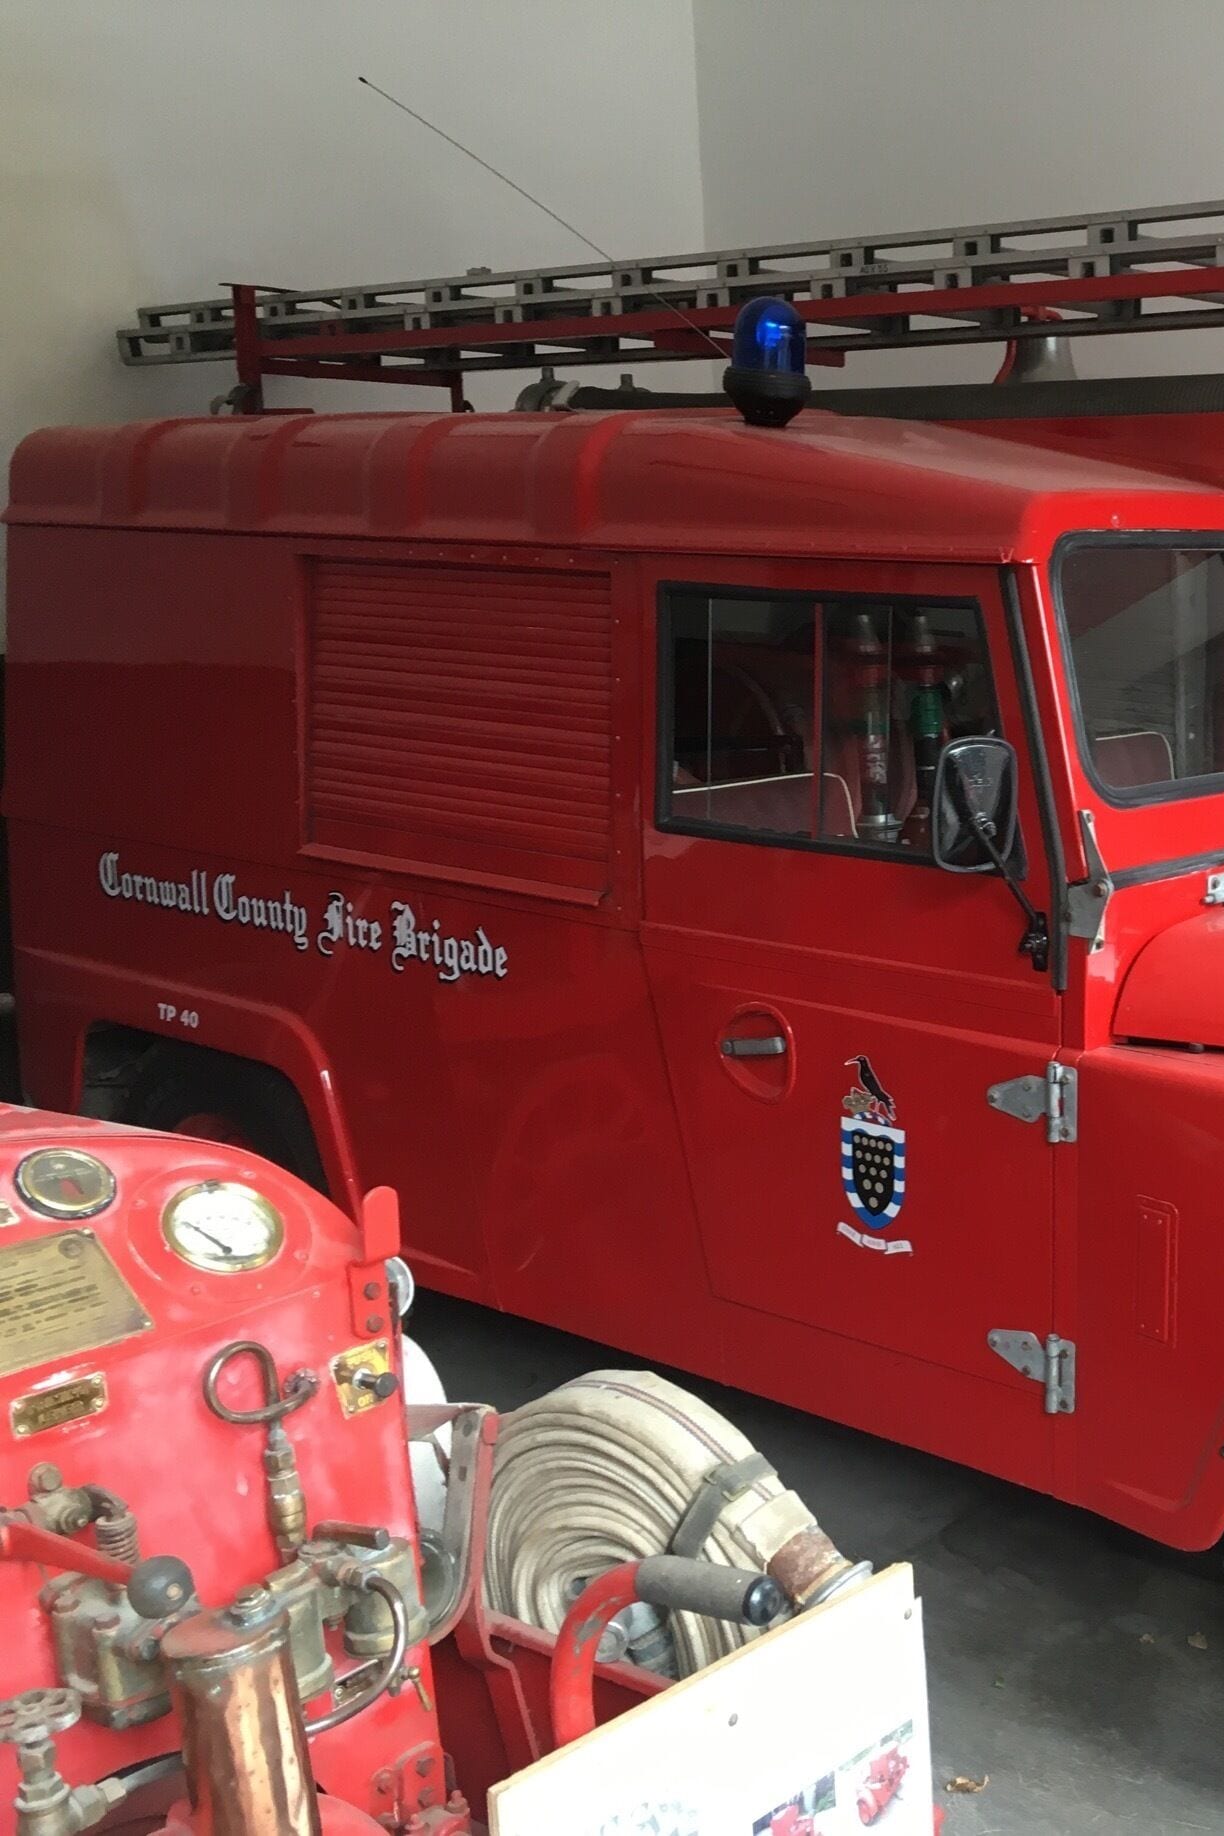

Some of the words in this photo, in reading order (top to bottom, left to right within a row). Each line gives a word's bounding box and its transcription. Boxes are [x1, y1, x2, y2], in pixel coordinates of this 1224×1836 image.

[99, 852, 209, 915] Cornwall
[213, 873, 308, 950] County
[317, 892, 382, 955] Fire
[391, 901, 508, 980] Brigade
[157, 1003, 176, 1021] TP
[180, 1009, 199, 1028] 40
